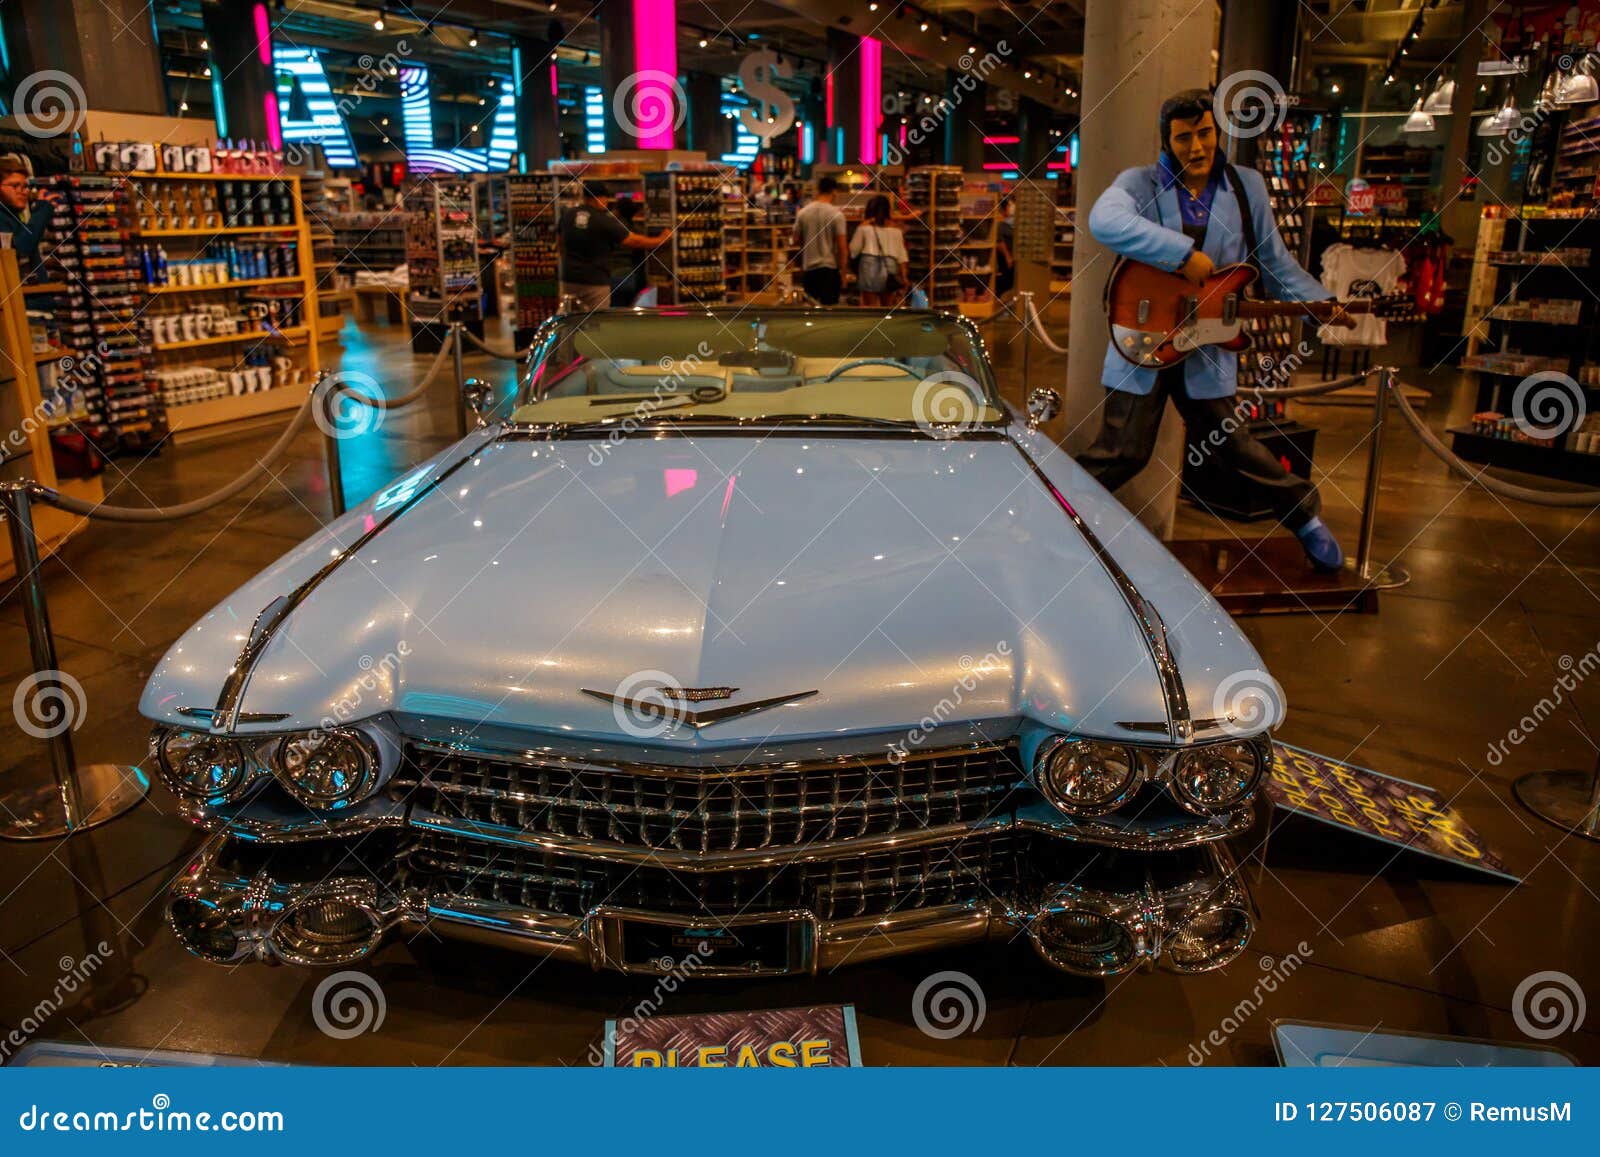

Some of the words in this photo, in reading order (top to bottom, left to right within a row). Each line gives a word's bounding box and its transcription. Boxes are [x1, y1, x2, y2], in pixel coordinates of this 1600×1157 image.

[1282, 746, 1331, 790] NOT
[1319, 793, 1357, 826] DO
[1324, 762, 1402, 837] TOUCH
[1407, 796, 1480, 858] CAR
